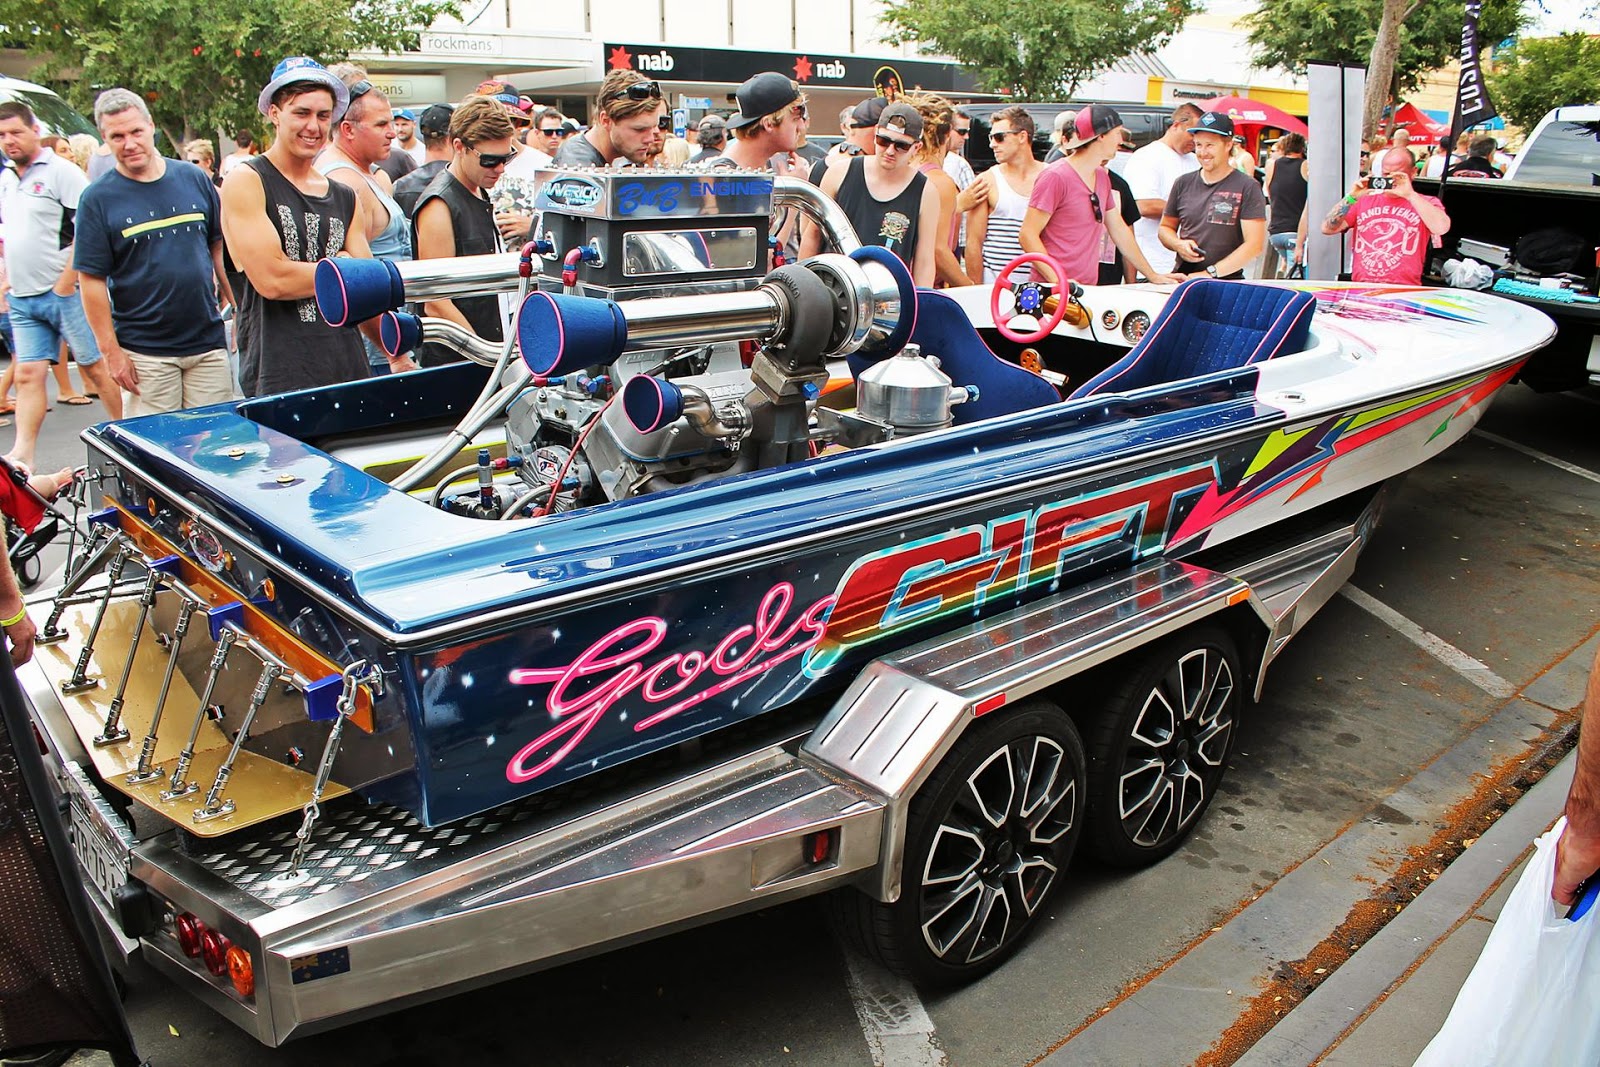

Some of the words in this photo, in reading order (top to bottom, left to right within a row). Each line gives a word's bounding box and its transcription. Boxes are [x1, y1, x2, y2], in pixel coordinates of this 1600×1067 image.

[428, 36, 493, 51] rockmans
[637, 50, 674, 71] nab
[816, 60, 846, 79] nab
[540, 182, 601, 200] MAVERICK
[690, 180, 774, 196] ENGINES
[1357, 206, 1381, 226] SAND
[1382, 205, 1390, 214] &
[1391, 206, 1421, 226] VENOM
[506, 582, 837, 783] Gods
[801, 455, 1222, 678] GIFT
